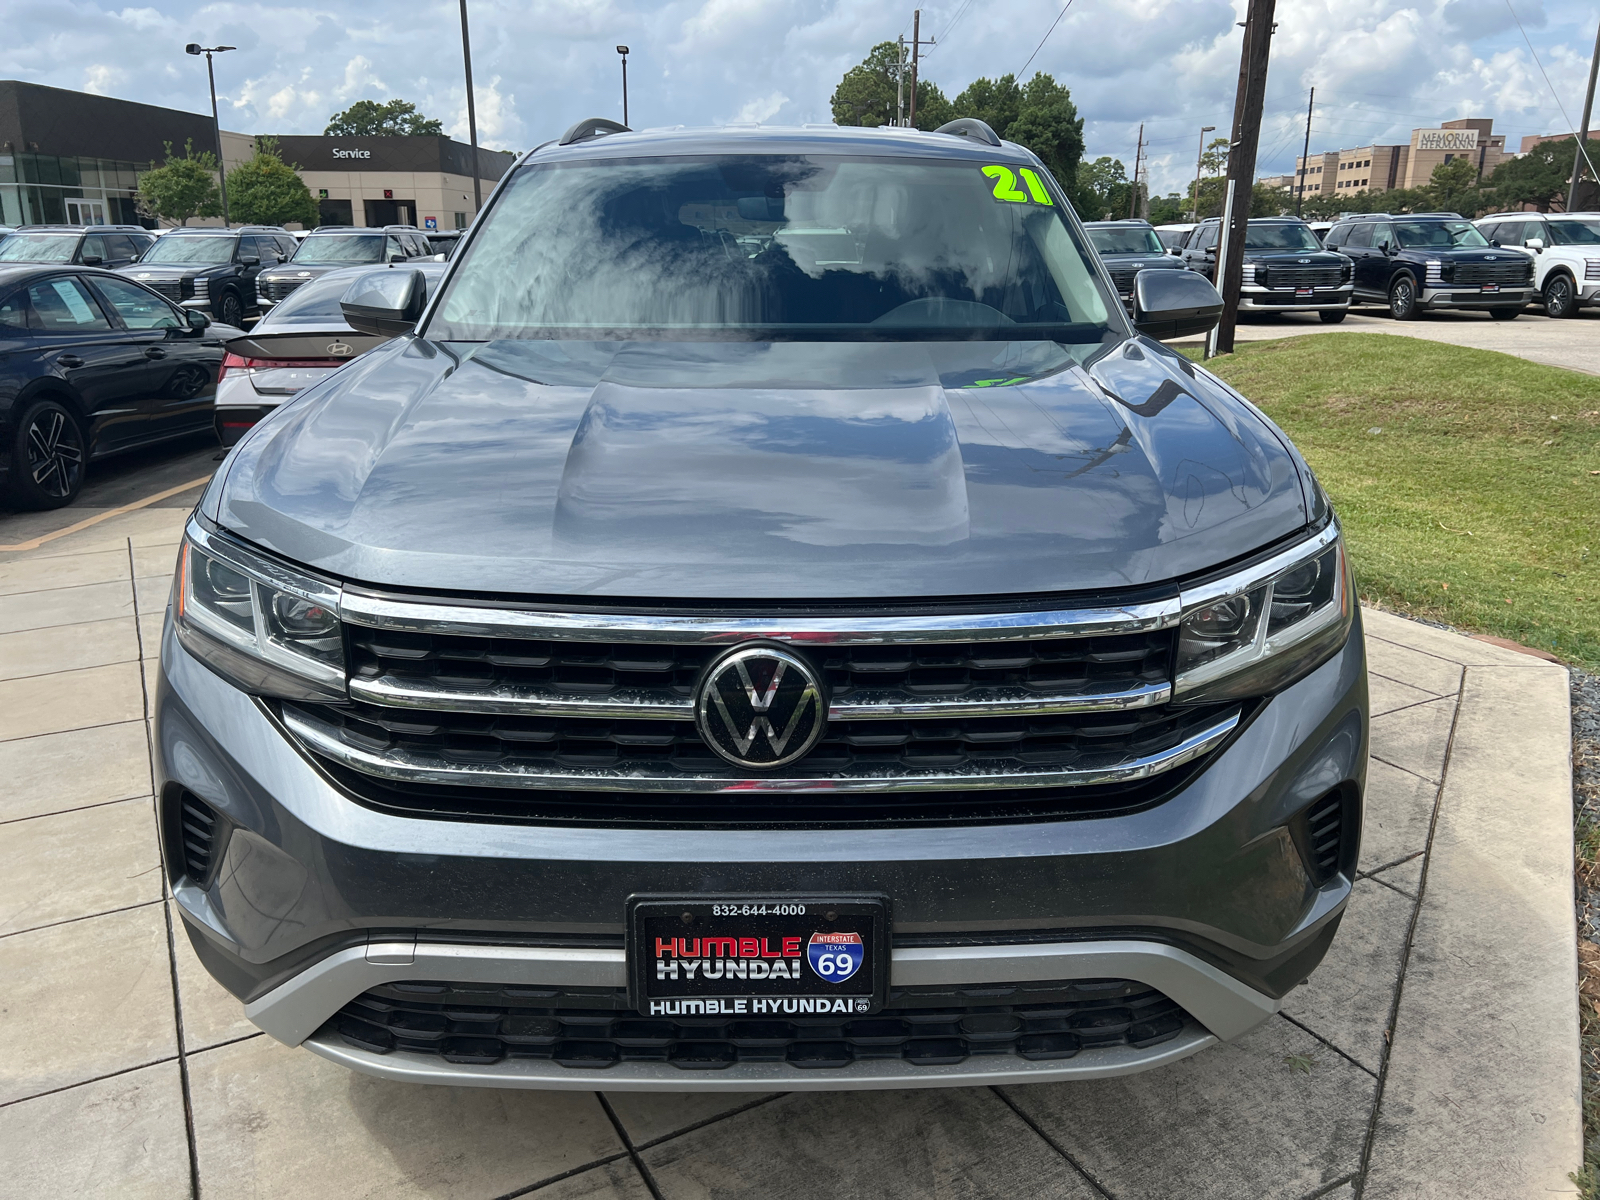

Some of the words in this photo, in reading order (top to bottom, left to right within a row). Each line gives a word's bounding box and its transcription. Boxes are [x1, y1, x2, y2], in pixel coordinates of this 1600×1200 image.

[1422, 131, 1475, 142] MEMORIAL
[1420, 140, 1475, 149] HERMANN
[332, 148, 371, 159] Service
[981, 165, 1054, 206] 21
[712, 904, 806, 916] 832-644-4000
[816, 935, 855, 944] INTERSTATE
[655, 936, 801, 958] HUMBLE
[824, 944, 847, 952] TEXAS
[656, 959, 801, 980] HYUNDAI
[817, 953, 854, 976] 69
[650, 999, 748, 1016] HUMBLE
[752, 998, 853, 1014] HYUNDAI
